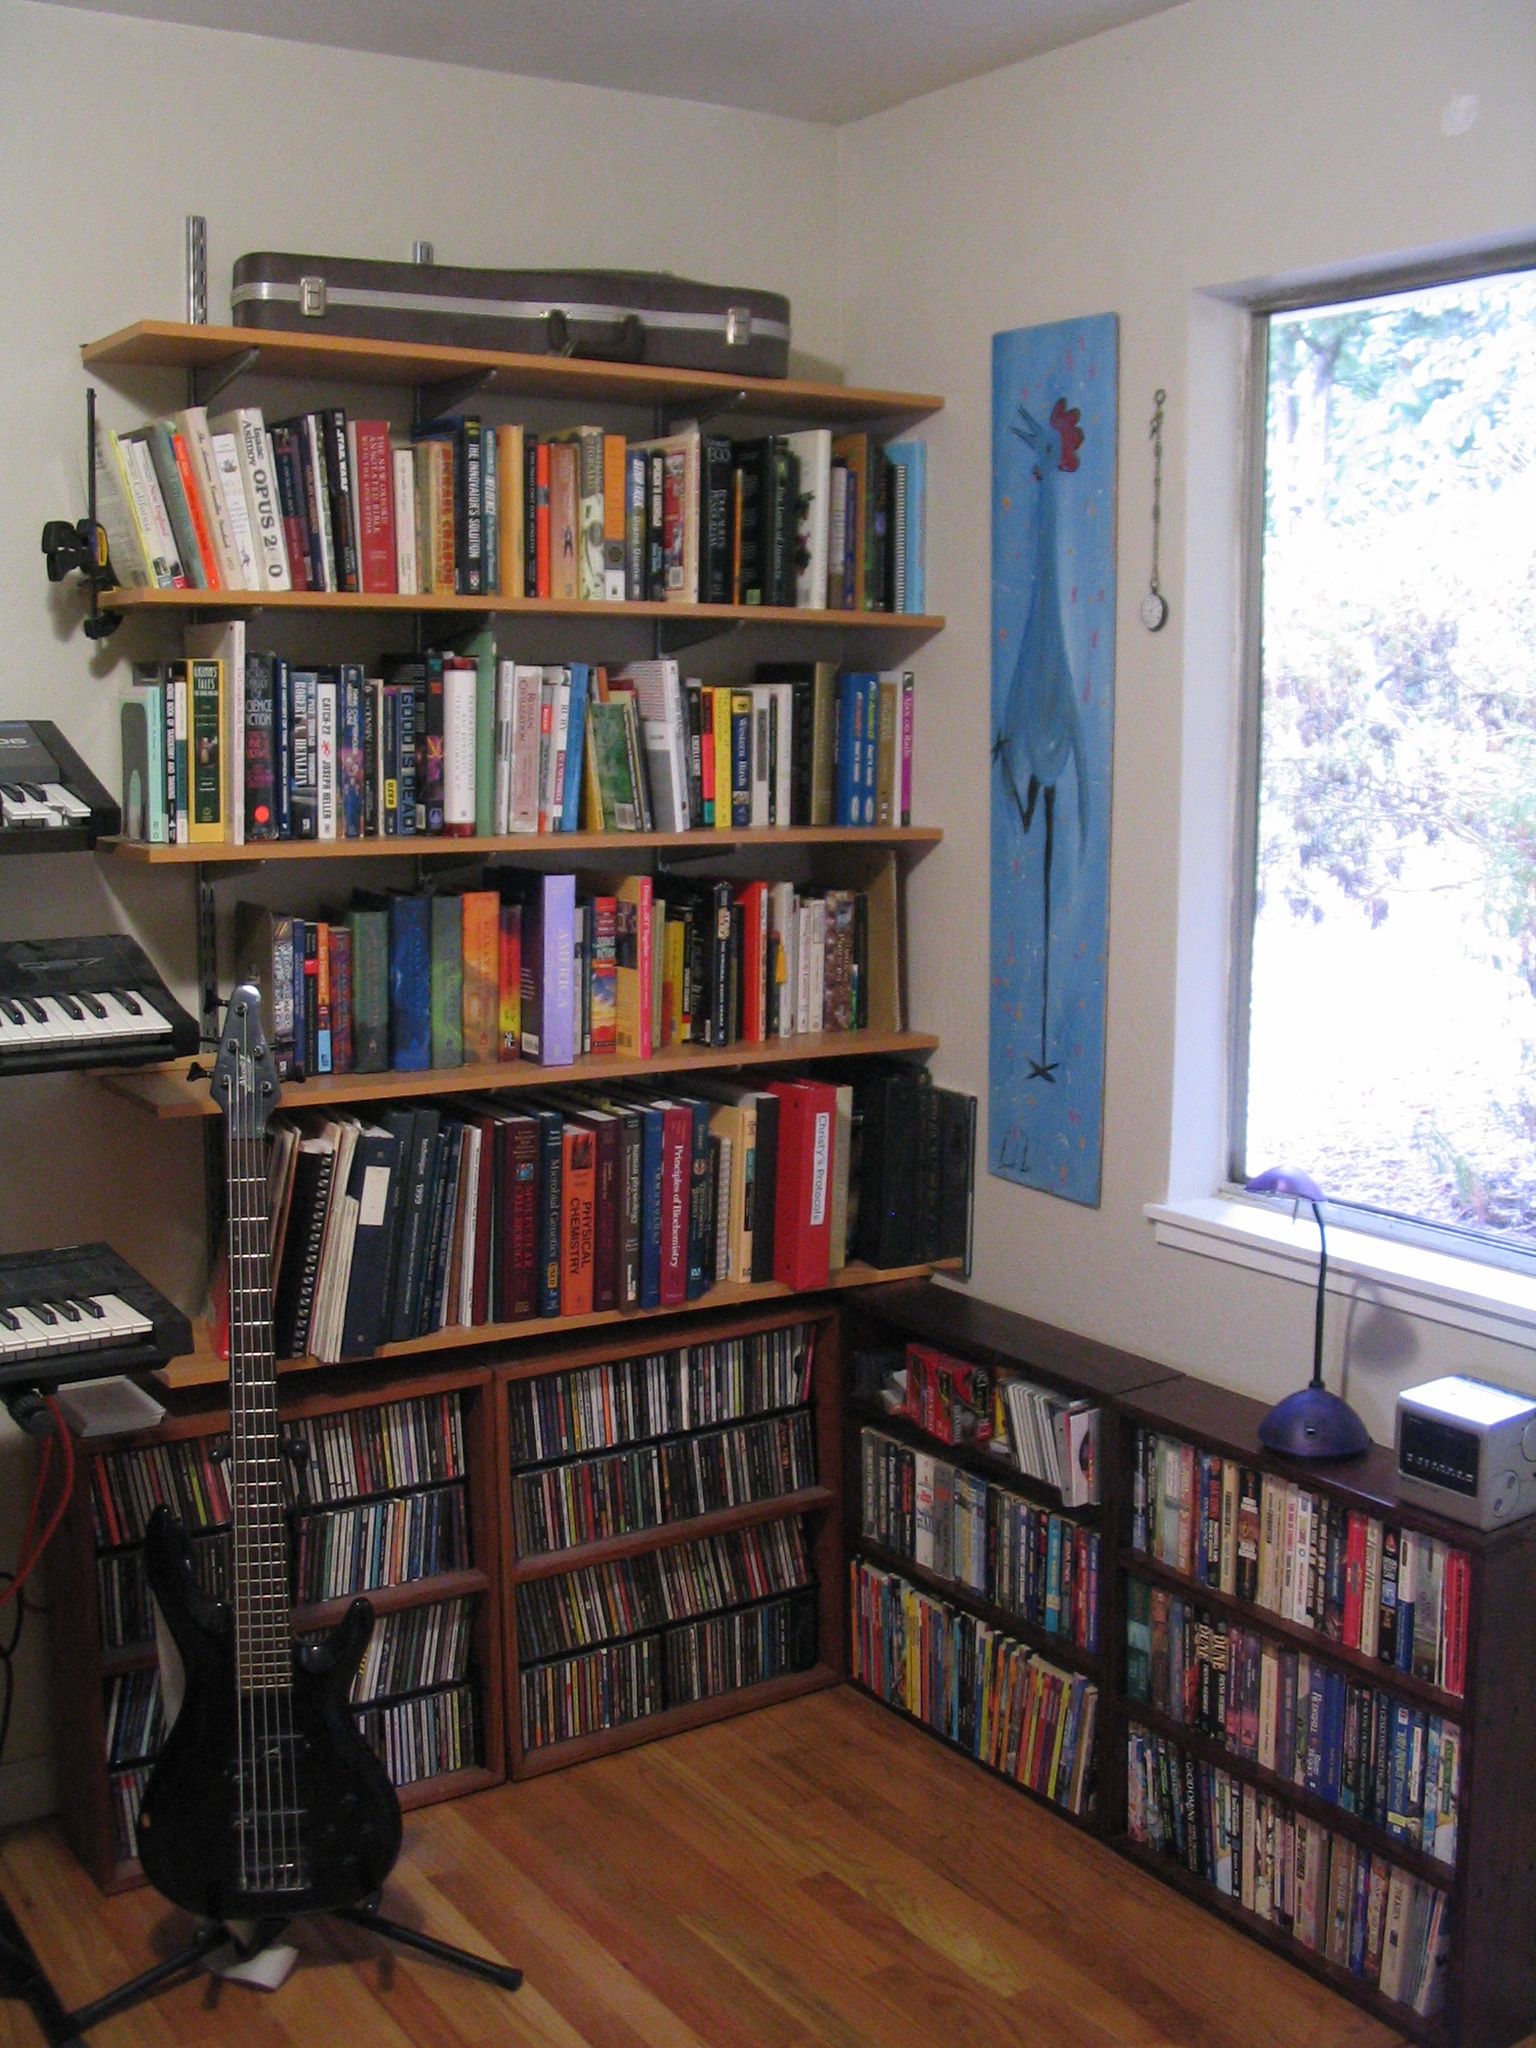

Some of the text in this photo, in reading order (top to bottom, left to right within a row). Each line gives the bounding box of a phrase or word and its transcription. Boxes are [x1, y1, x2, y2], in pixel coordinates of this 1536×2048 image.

[242, 420, 257, 465] Asimov
[254, 427, 265, 460] Isaac
[337, 429, 349, 492] STAR WARS
[378, 458, 386, 480] NEW
[133, 482, 151, 531] California
[149, 484, 169, 536] New England
[253, 469, 275, 529] OPUS
[373, 504, 381, 533] BIBLE
[468, 443, 480, 558] THE INNOVATOR'S SOLUTION
[294, 682, 307, 785] ROBERT HEINLEIN
[559, 704, 568, 732] RUBY
[322, 697, 331, 819] CATCH-22 JOSEPH HELLER
[738, 717, 747, 786] Western Birds
[417, 1138, 429, 1176] technique
[629, 1143, 640, 1225] human physiology
[672, 1145, 684, 1193] Principles
[812, 1115, 828, 1221] Christy's Protocols
[414, 1183, 425, 1205] 1999
[548, 1159, 560, 1257] Microbial Genetics
[570, 1197, 580, 1275] CHEMISTRY
[581, 1201, 592, 1268] PHYSICAL
[670, 1205, 682, 1268] Biochemistry
[1199, 1623, 1212, 1662] DUNE
[1212, 1634, 1229, 1672] DUNE
[1184, 1761, 1195, 1823] GOOD OMENS
